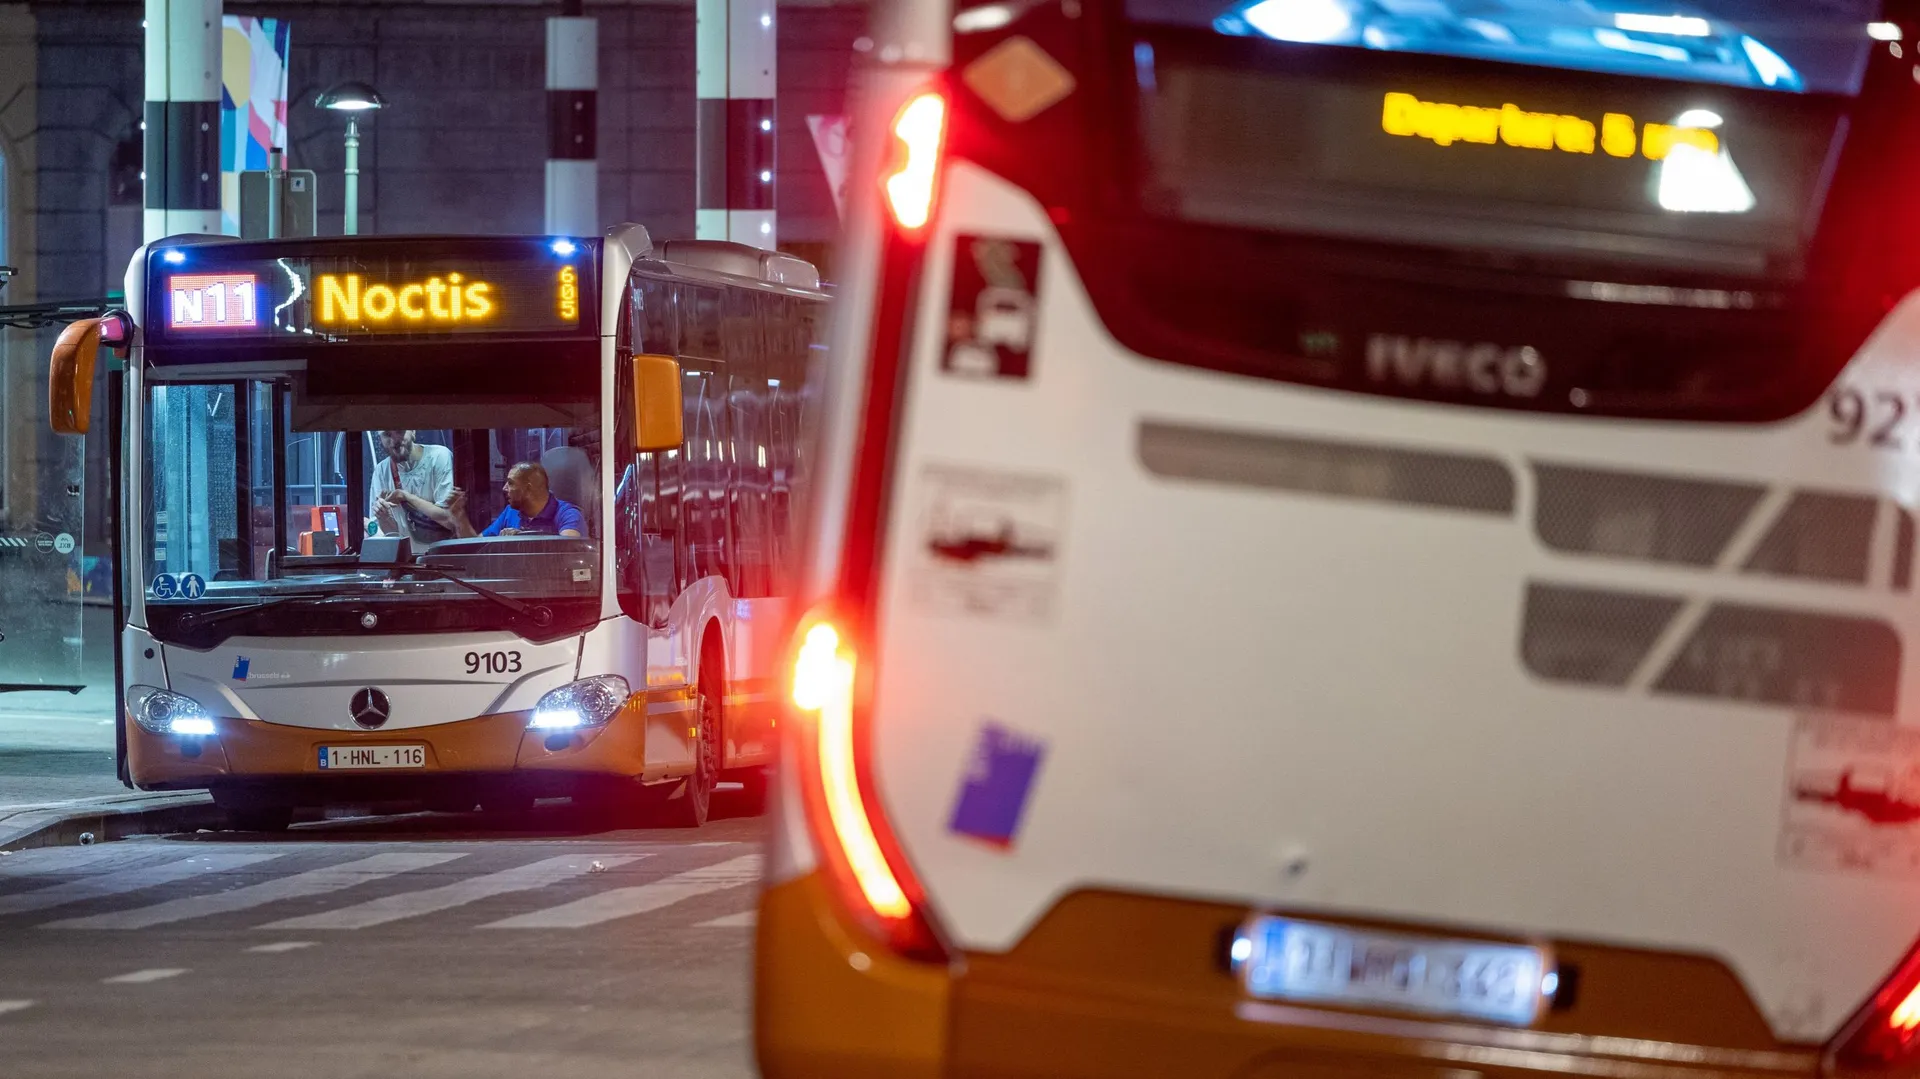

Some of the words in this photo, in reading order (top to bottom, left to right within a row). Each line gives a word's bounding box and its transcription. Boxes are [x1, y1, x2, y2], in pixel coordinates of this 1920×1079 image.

[173, 281, 254, 323] N11
[320, 272, 493, 321] Noctis
[1366, 333, 1547, 397] IVECO
[1829, 388, 1920, 450] 92
[464, 650, 522, 674] 9103
[320, 759, 327, 767] B
[332, 749, 422, 765] 1-HNL-116
